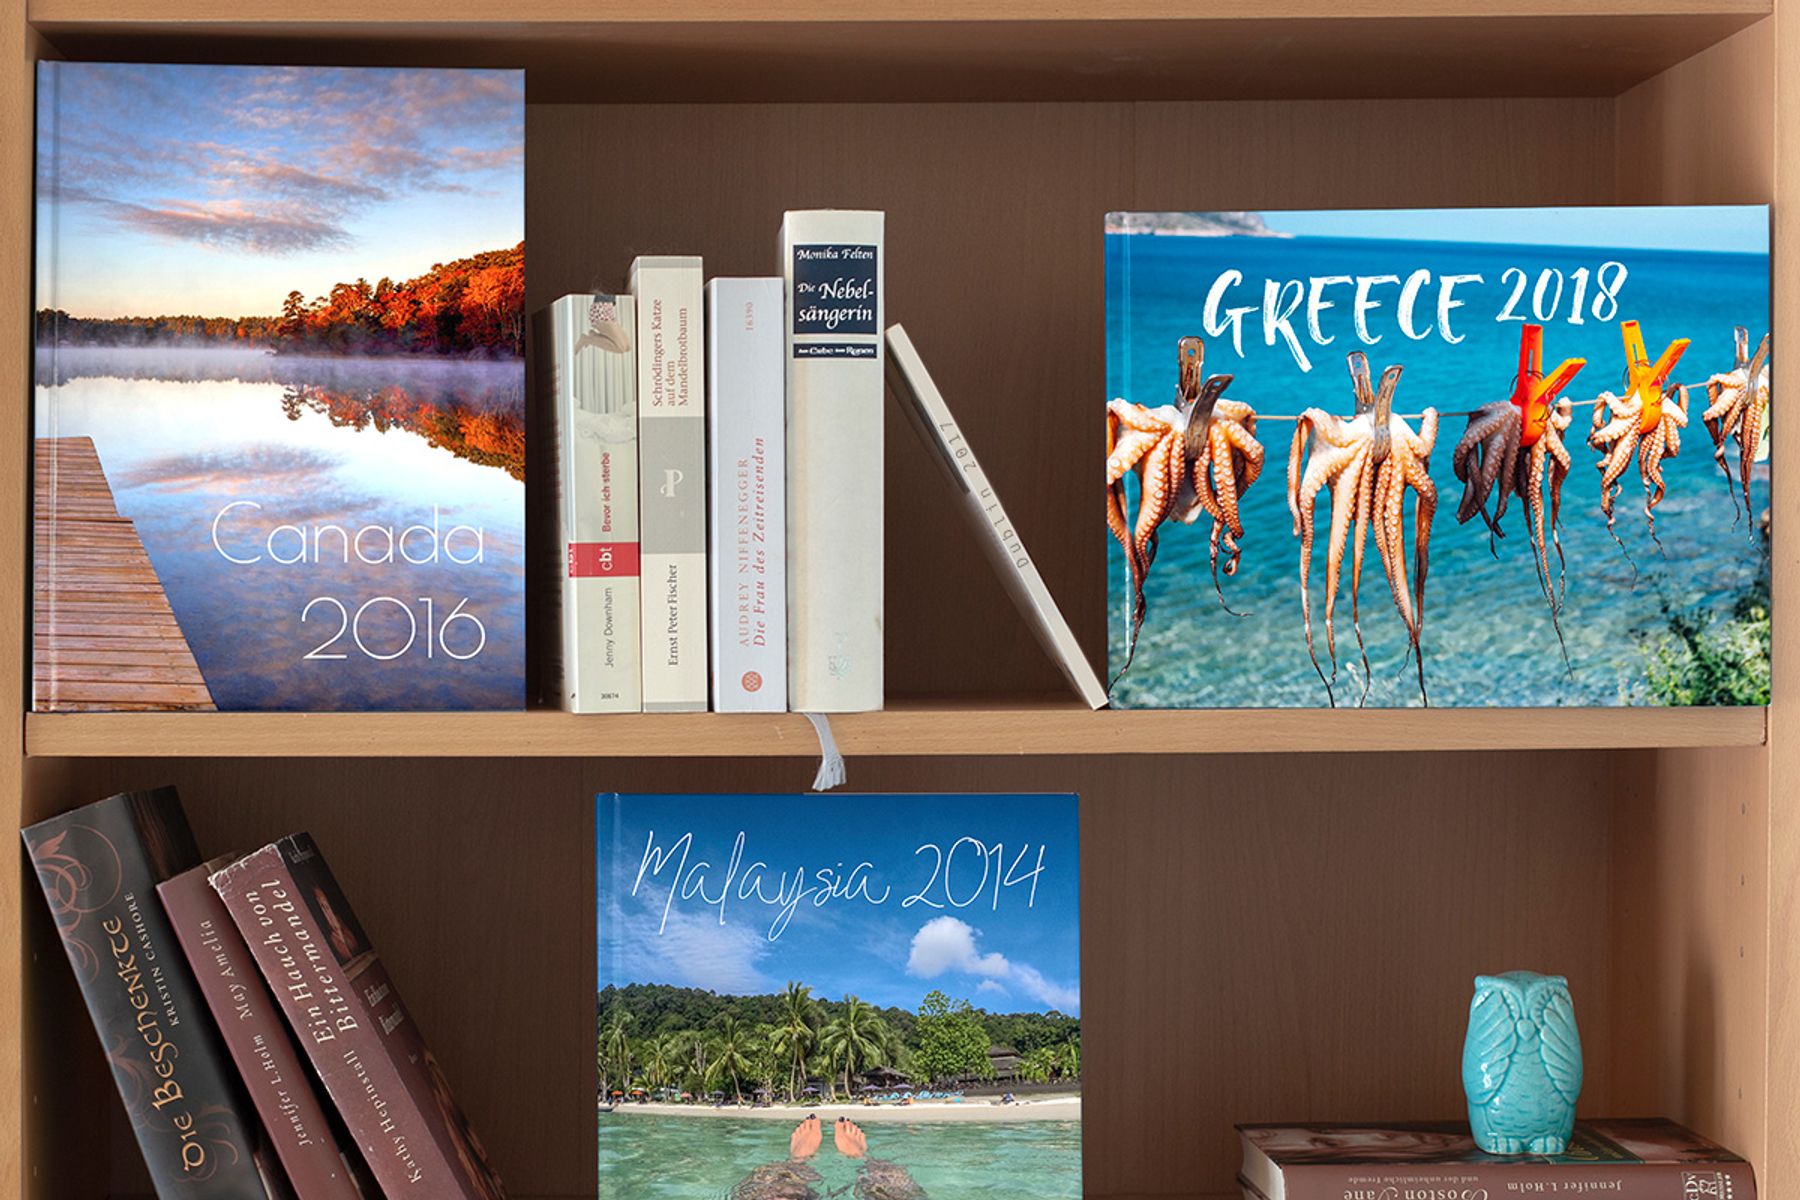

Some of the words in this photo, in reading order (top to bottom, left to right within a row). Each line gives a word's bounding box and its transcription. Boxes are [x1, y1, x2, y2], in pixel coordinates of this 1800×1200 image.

[797, 248, 838, 260] Monika
[841, 248, 873, 260] Felten
[798, 283, 815, 294] Die
[819, 278, 874, 299] Nebel-
[652, 299, 662, 329] Katze
[798, 305, 873, 328] sängerin
[1202, 268, 1485, 373] GREECE
[1495, 261, 1629, 325] 2018
[652, 332, 664, 407] Schrödingers
[667, 361, 676, 382] dem
[677, 307, 688, 407] Mandelbrotbaum
[667, 385, 676, 407] auf
[939, 422, 977, 473] 2017
[602, 452, 611, 484] sterbe
[602, 486, 611, 505] ich
[752, 437, 766, 542] Zeitreisenden
[212, 500, 484, 564] Canada
[602, 507, 611, 533] Bevor
[739, 458, 749, 573] NIFFENEGGER
[981, 487, 1030, 569] Dublin
[600, 547, 613, 572] cbt
[753, 556, 766, 574] des
[668, 564, 678, 603] Fischer
[753, 581, 766, 616] Frau
[301, 596, 486, 660] 2016
[604, 587, 613, 636] Downham
[668, 604, 678, 631] Peter
[739, 583, 749, 647] AUDREY
[604, 638, 615, 667] Jenny
[668, 633, 678, 666] Ernst
[753, 621, 766, 647] Die
[631, 830, 891, 942] Malaysia
[902, 836, 1046, 911] 2014
[125, 892, 156, 961] CASHORE
[246, 890, 273, 927] von
[200, 920, 234, 978] Amelia
[261, 878, 359, 1033] Bittermandel
[264, 932, 313, 1002] Hauch
[151, 967, 180, 1027] KRISTIN
[229, 982, 253, 1020] May
[307, 1006, 335, 1045] Ein
[343, 1050, 395, 1133] Hepinstall
[279, 1089, 313, 1146] Jennifer
[392, 1136, 423, 1184] Kathy
[1384, 1176, 1442, 1185] unheimliche
[1564, 1180, 1623, 1192] Jennifer
